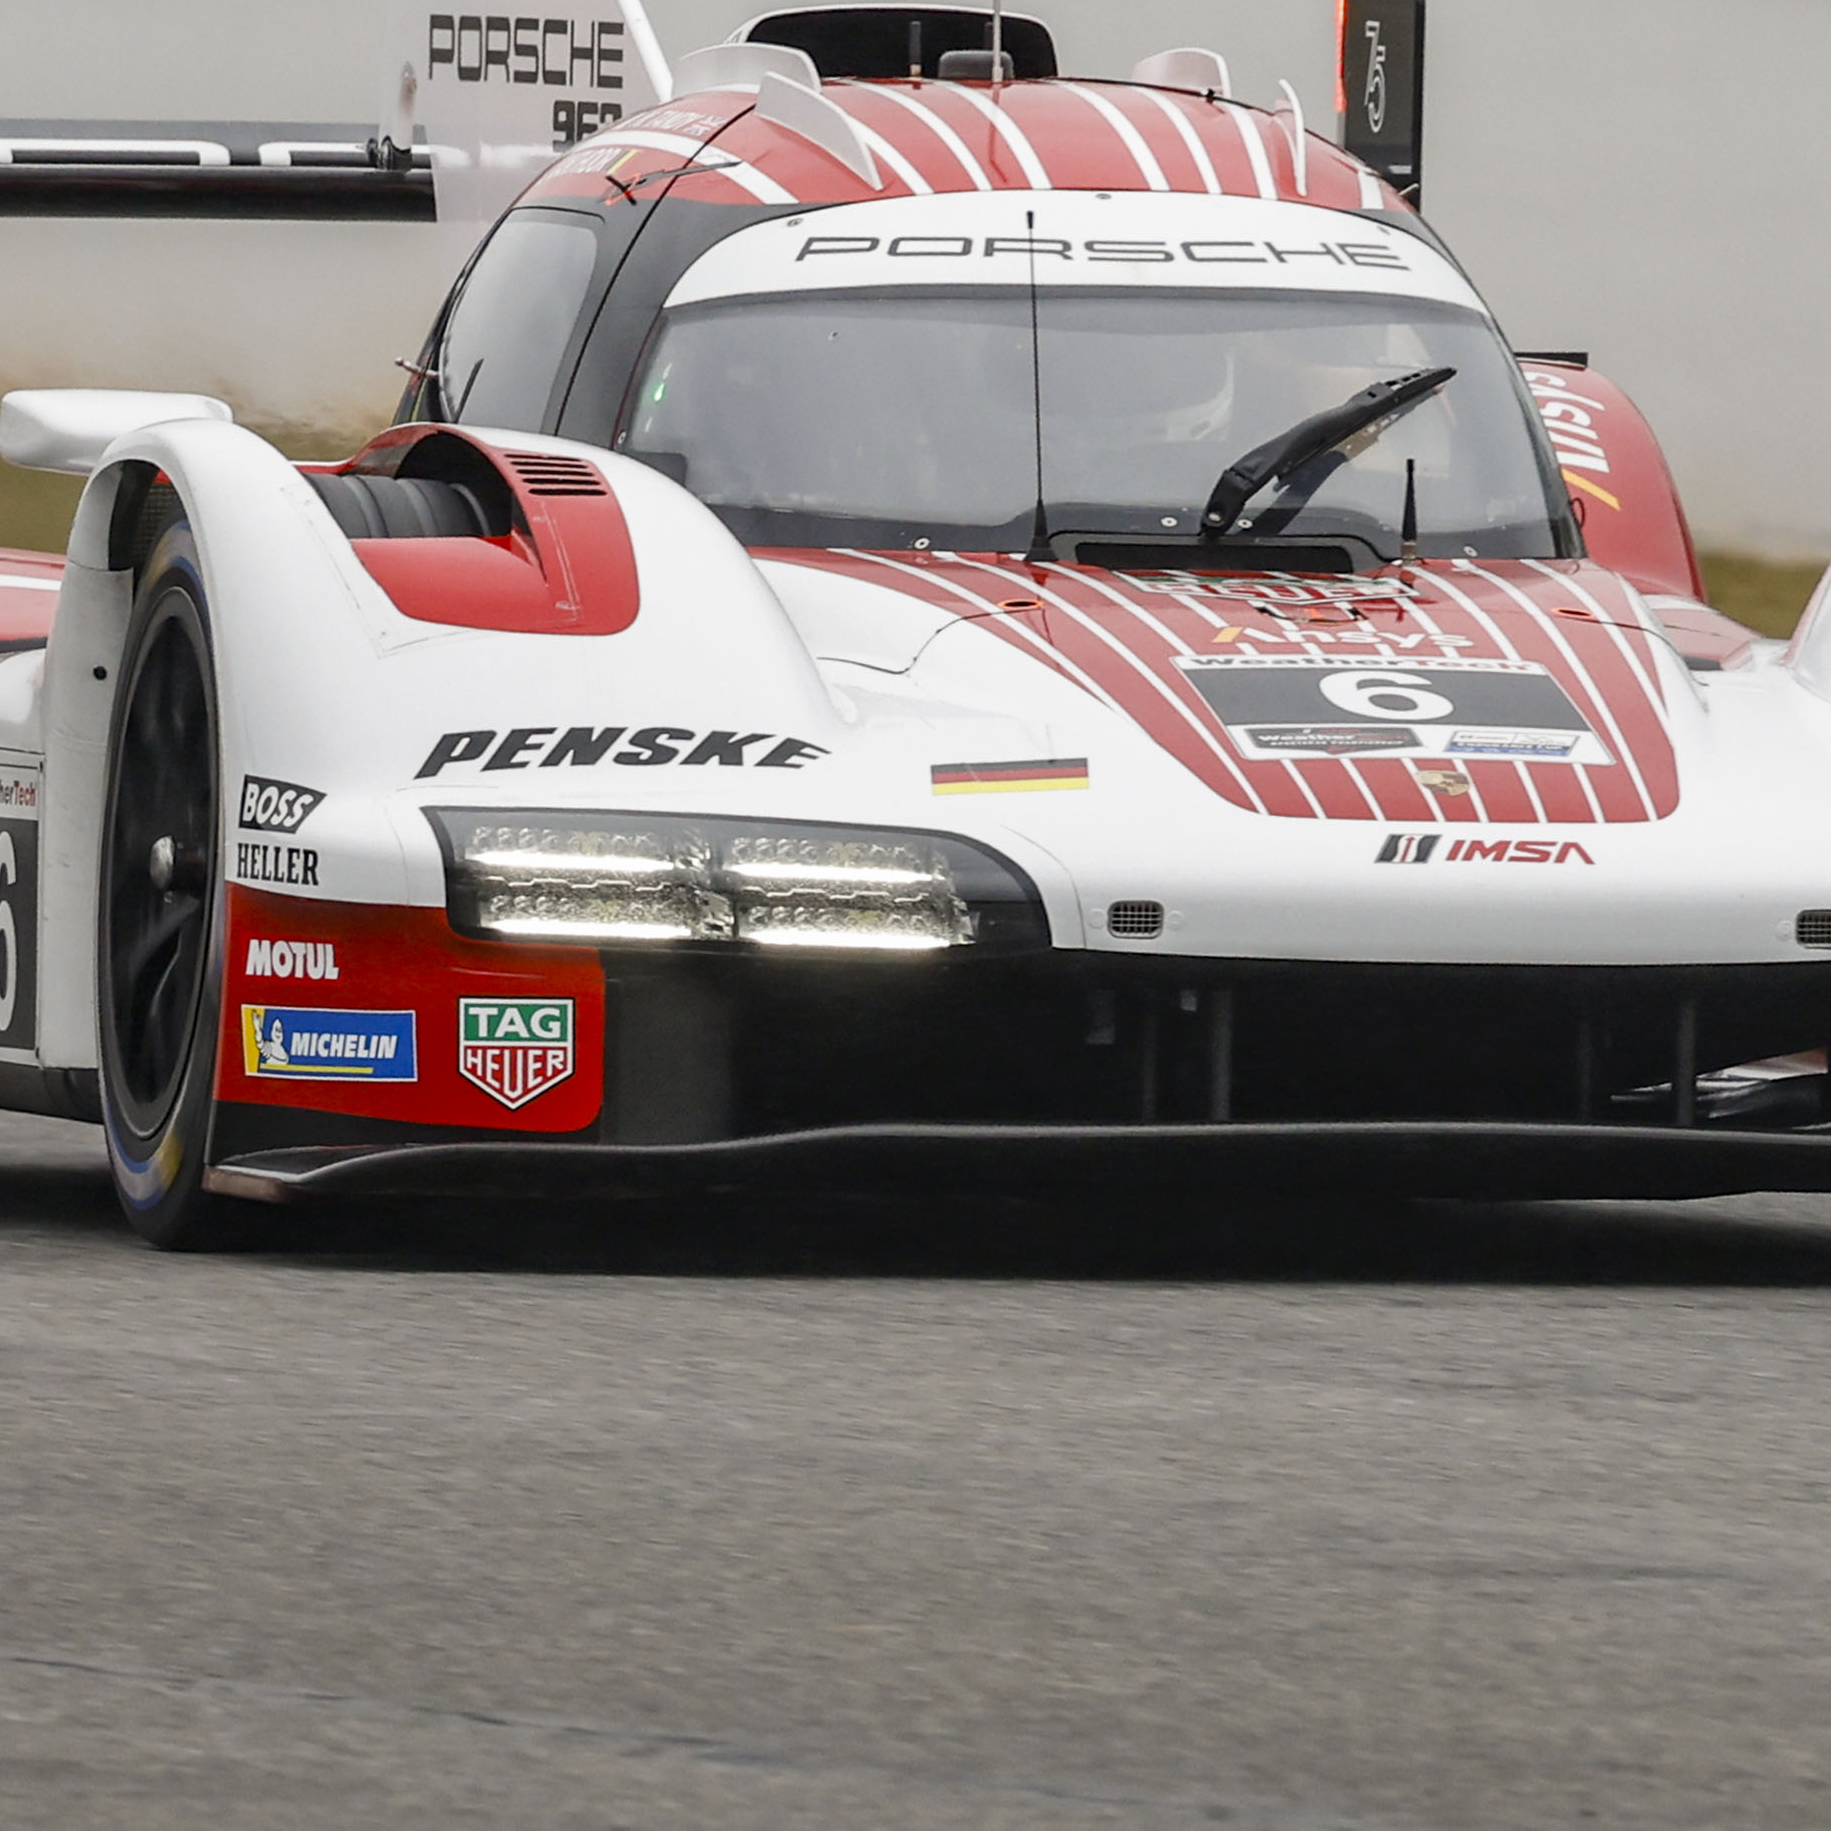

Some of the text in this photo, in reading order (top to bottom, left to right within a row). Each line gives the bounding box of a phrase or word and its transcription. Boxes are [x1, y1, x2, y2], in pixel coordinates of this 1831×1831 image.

[428, 13, 625, 89] PORSCHE
[794, 236, 1413, 272] PORSCHE
[1318, 670, 1455, 722] 6
[412, 725, 833, 781] PENSKE
[241, 778, 315, 828] BOSS
[236, 841, 320, 886] HELLER
[1444, 838, 1597, 866] IMSA
[244, 938, 341, 981] MOTUL
[467, 1006, 563, 1040] TAG
[289, 1031, 399, 1061] MICHELIN
[465, 1047, 565, 1100] HEUER
